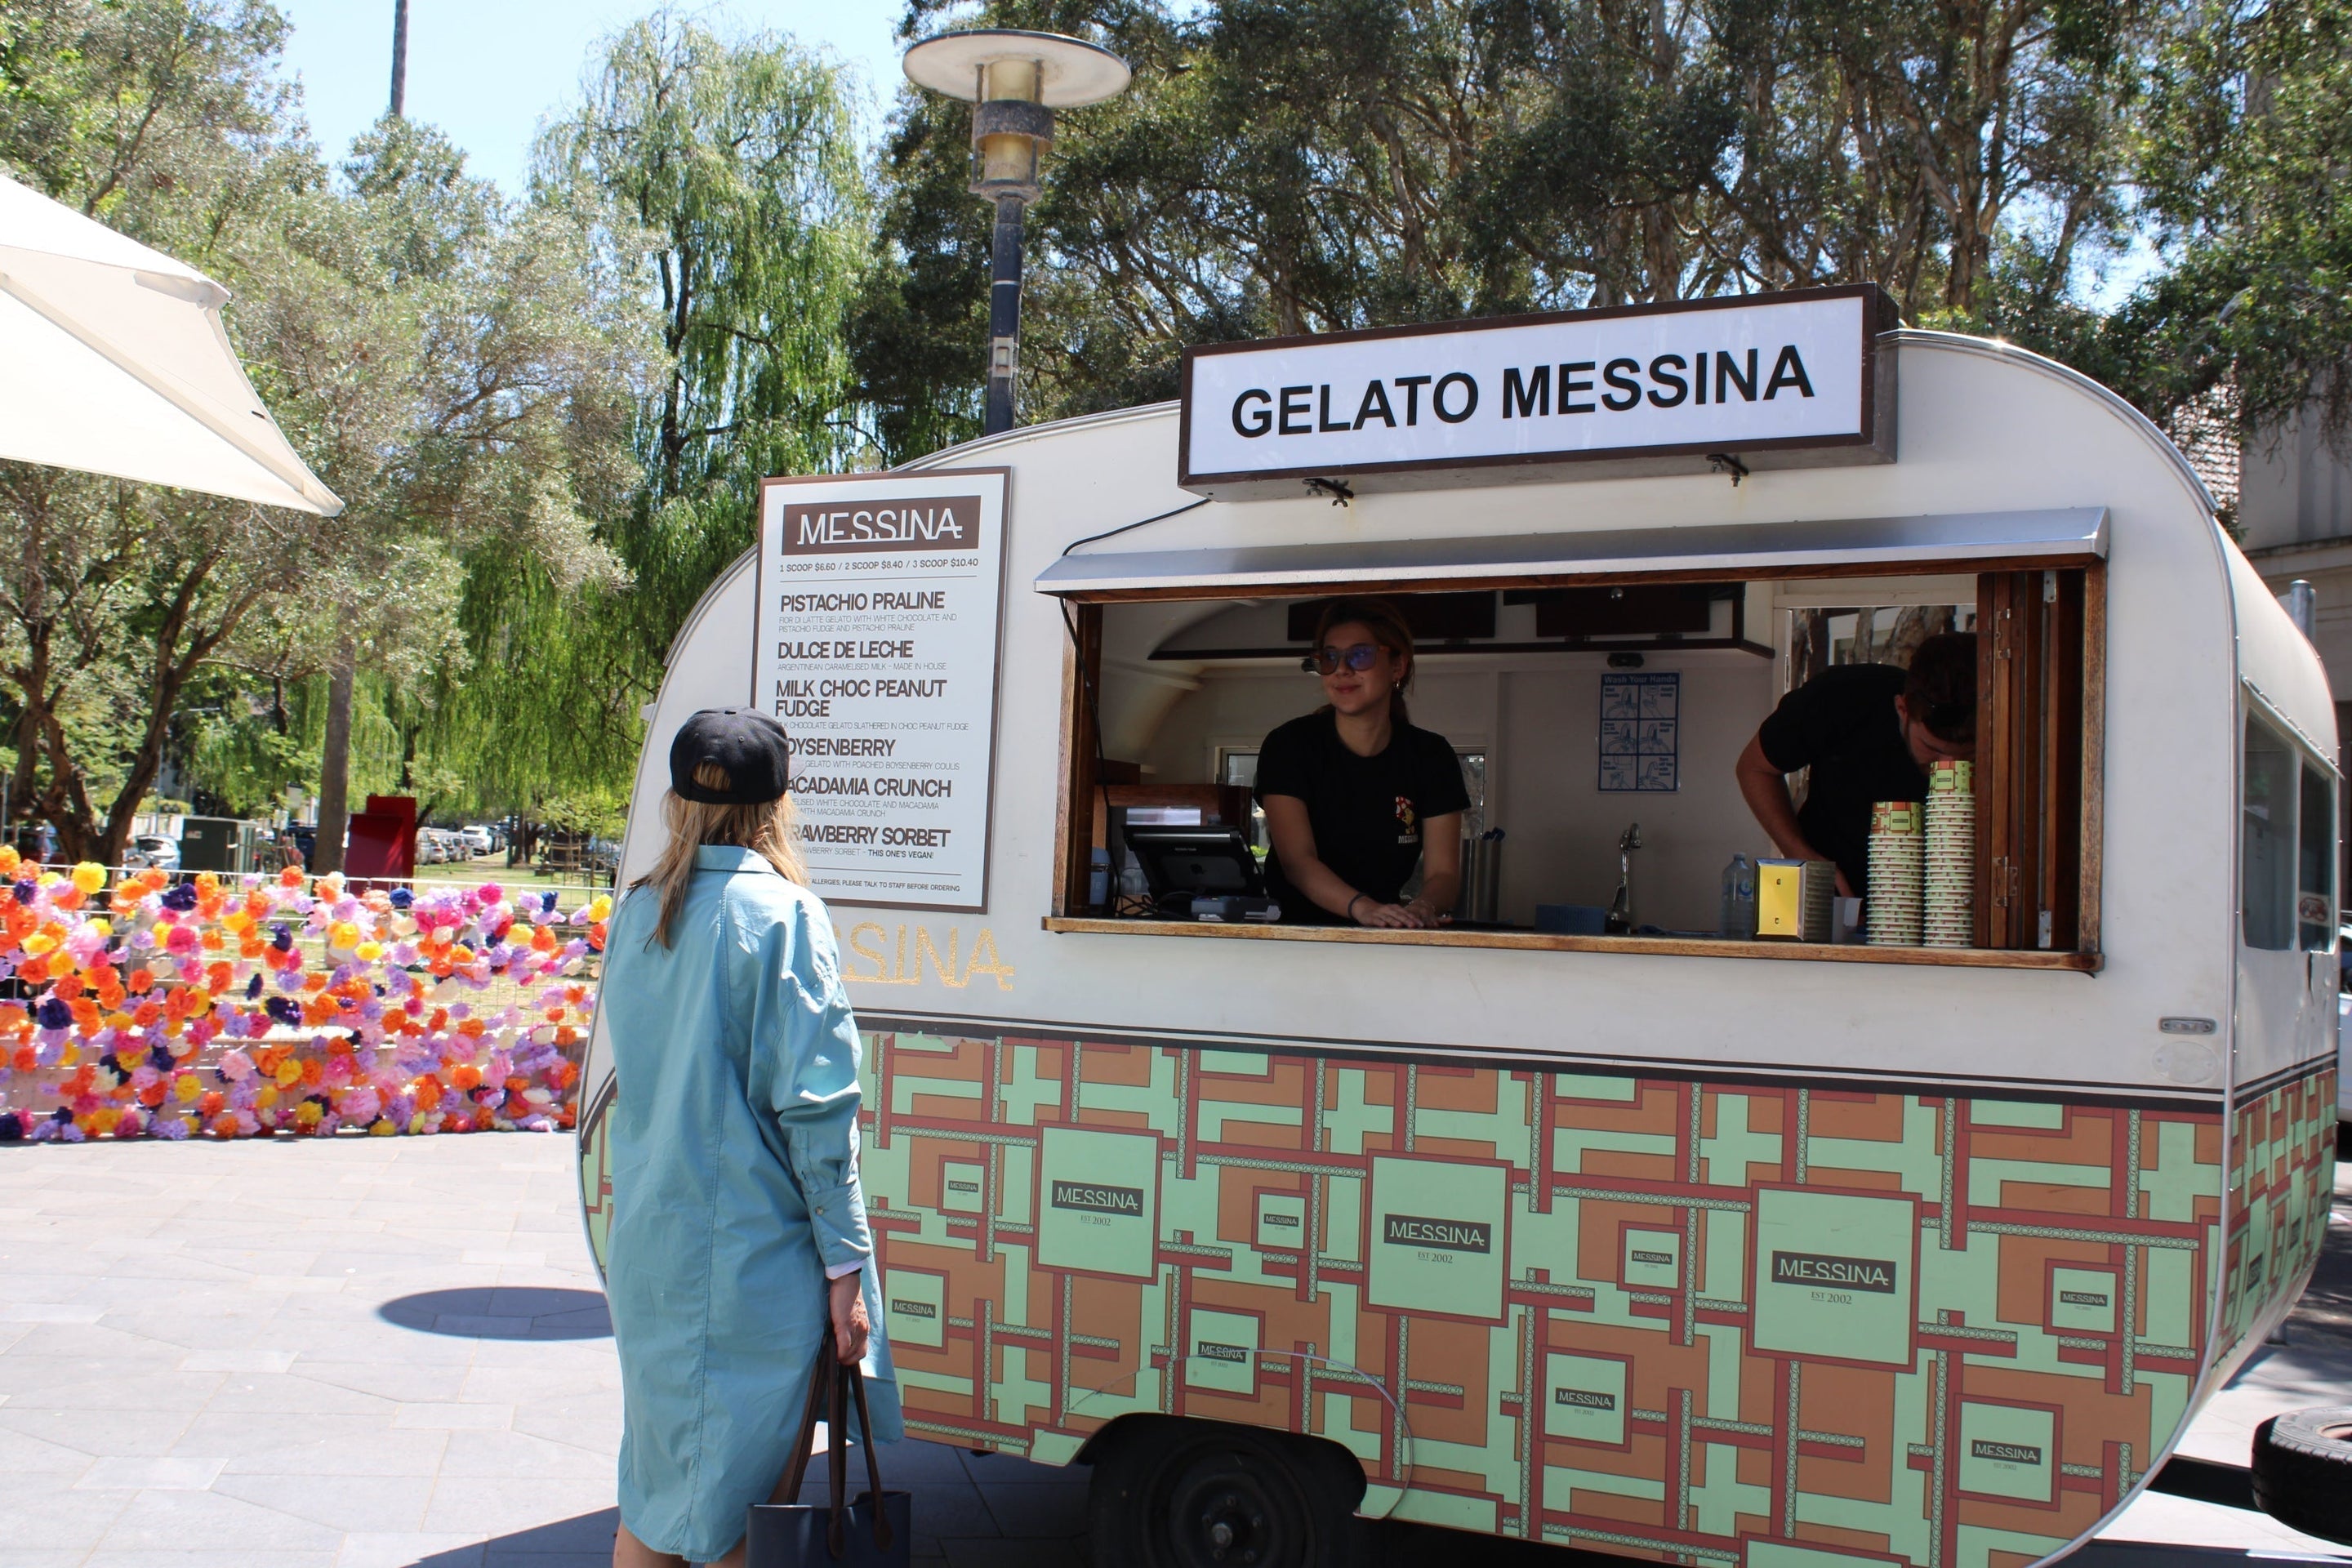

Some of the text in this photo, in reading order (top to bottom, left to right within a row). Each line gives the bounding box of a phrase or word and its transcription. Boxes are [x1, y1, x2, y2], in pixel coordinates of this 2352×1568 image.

[1231, 344, 1815, 439] GELATO MESSINA
[797, 508, 963, 545] MESSINA
[780, 564, 784, 572] 1
[786, 563, 813, 572] SCOOP
[814, 562, 835, 572] $6.60
[844, 562, 850, 570] 2
[852, 561, 880, 570] SCOOP
[881, 559, 903, 569] $8.40
[912, 560, 918, 568] 3
[920, 559, 948, 568] SCOOP
[951, 558, 978, 567] $10.40
[781, 591, 946, 612] PISTACHIO PRALINE
[802, 616, 824, 624] LATTE
[825, 615, 852, 623] GELATO
[853, 615, 871, 623] WITH
[873, 614, 896, 622] WHITE
[898, 614, 940, 622] CHOCOLATE
[942, 613, 957, 621] AND
[778, 623, 915, 633] PISTACHIO FUDGE AND PISTACHIO PRALINE
[777, 640, 914, 659] DULCE DE LECHE
[777, 663, 823, 671] ARGENTINEAN
[824, 663, 870, 671] CARAMELISED
[871, 662, 886, 670] MILK
[893, 662, 913, 670] MADE
[915, 662, 922, 670] IN
[924, 662, 947, 670] HOUSE
[1604, 675, 1677, 684] Wash Your Hands
[776, 679, 947, 697] MILK CHOC PEANUT
[775, 700, 831, 717] FUDGE
[854, 722, 890, 730] SLATHERED
[947, 723, 969, 731] FUDGE
[787, 737, 896, 756] OYSENBERRY
[805, 760, 831, 768] GELATO
[852, 761, 884, 769] POACHED
[885, 761, 933, 770] BOYSENBERRY
[934, 762, 960, 770] COULIS
[788, 777, 951, 798] ACADAMIA CRUNCH
[817, 799, 837, 807] WHITE
[840, 800, 881, 808] CHOCOLATE
[882, 800, 897, 808] AND
[898, 801, 939, 809] MACADAMIA
[817, 808, 855, 817] MACADAMIA
[857, 808, 886, 817] CRUNCH
[881, 827, 951, 848] SORBET
[834, 847, 861, 856] SORBET
[868, 849, 884, 857] THIS
[885, 849, 906, 858] ONE'S
[908, 850, 934, 859] VEGAN!
[930, 884, 960, 893] ORDERING
[833, 921, 1015, 991] SINA
[949, 1181, 978, 1192] MESSINA
[1057, 1187, 1138, 1210] MESSINA
[1092, 1216, 1111, 1226] 2002
[1264, 1214, 1298, 1227] MESSINA
[1389, 1221, 1485, 1246] MESSINA
[1418, 1250, 1453, 1263] EST 2002
[1633, 1252, 1671, 1263] MESSINA
[1778, 1258, 1889, 1286] MESSINA
[1811, 1291, 1852, 1304] EST 2002
[2062, 1292, 2105, 1305] MESSINA
[894, 1302, 934, 1316] MESSINA
[1559, 1391, 1613, 1407] MESSINA
[1975, 1444, 2038, 1462] MESSINA
